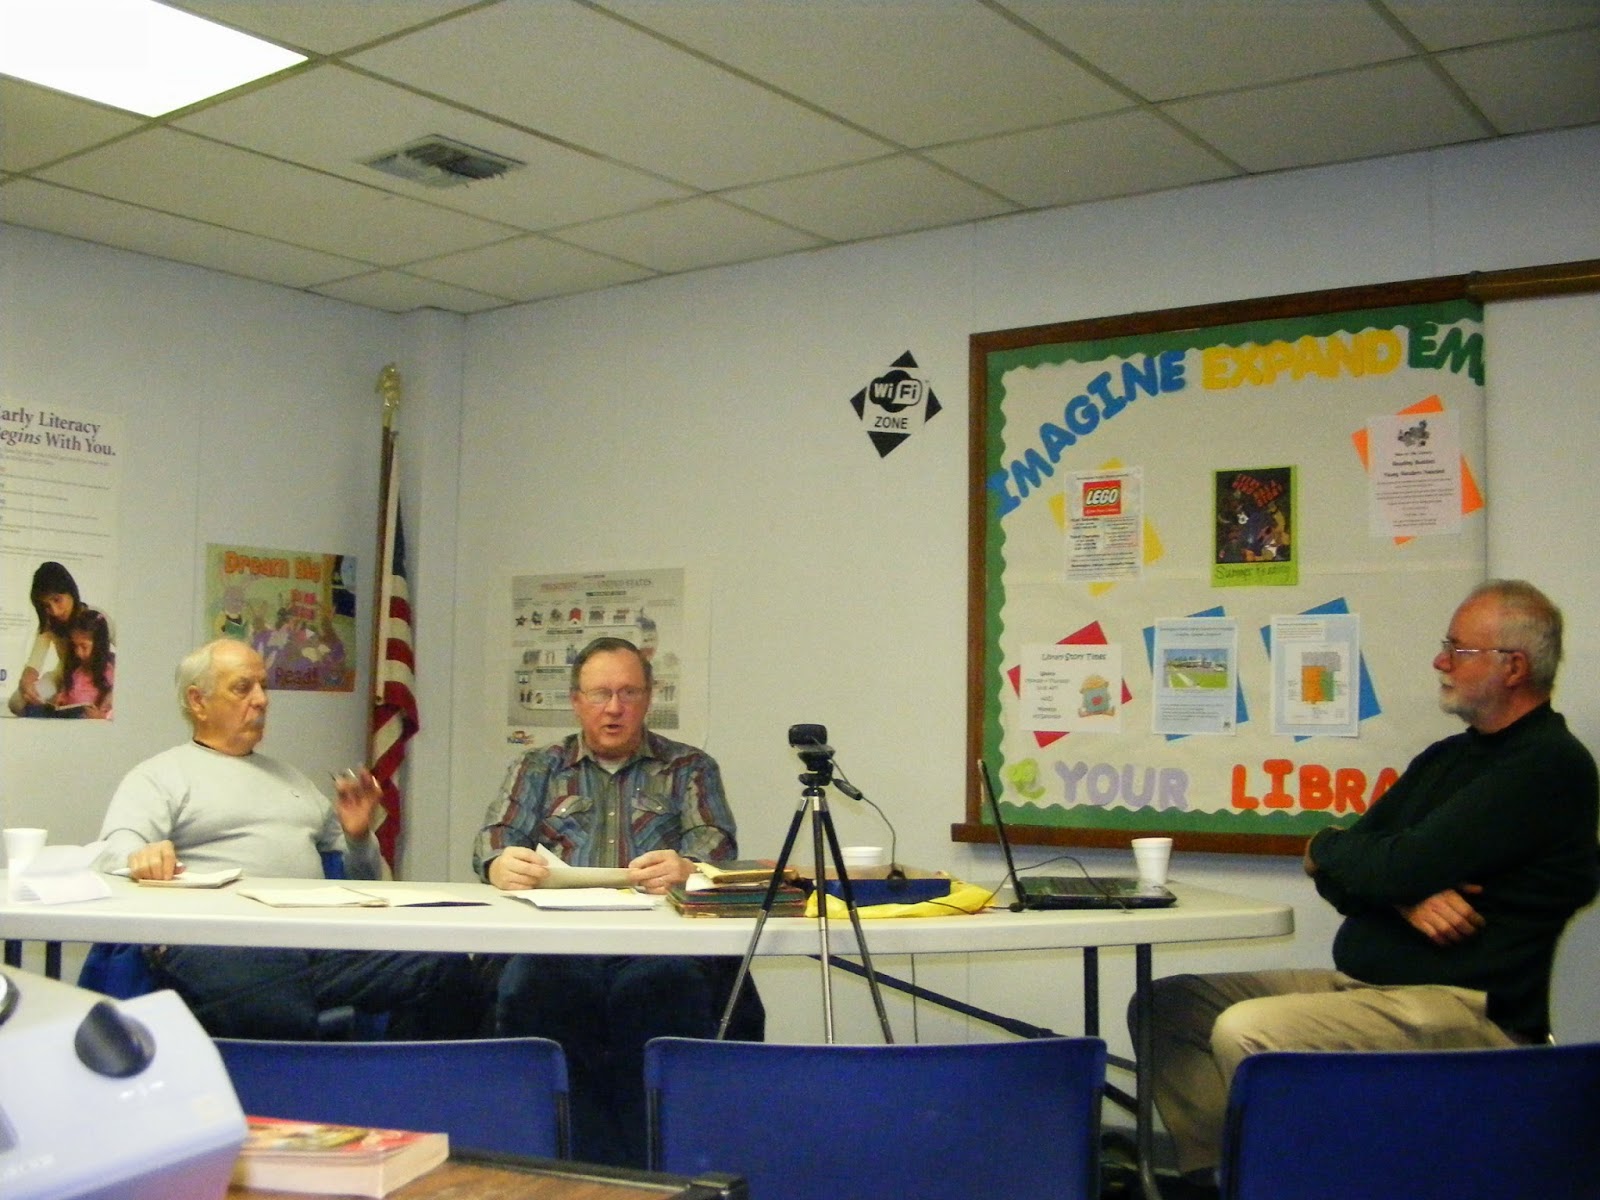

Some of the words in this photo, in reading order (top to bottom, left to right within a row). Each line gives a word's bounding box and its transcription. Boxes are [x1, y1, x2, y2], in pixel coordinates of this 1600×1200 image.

[0, 407, 34, 429] arly
[39, 411, 101, 439] Literacy
[874, 416, 909, 430] ZONE
[987, 350, 1187, 519] IMAGINE
[1202, 328, 1403, 390] EXPAND
[0, 427, 42, 446] egins
[46, 432, 81, 451] With
[85, 438, 116, 456] You.
[1086, 488, 1119, 506] LEGO
[224, 550, 289, 579] Dream
[1054, 760, 1191, 811] YOUR
